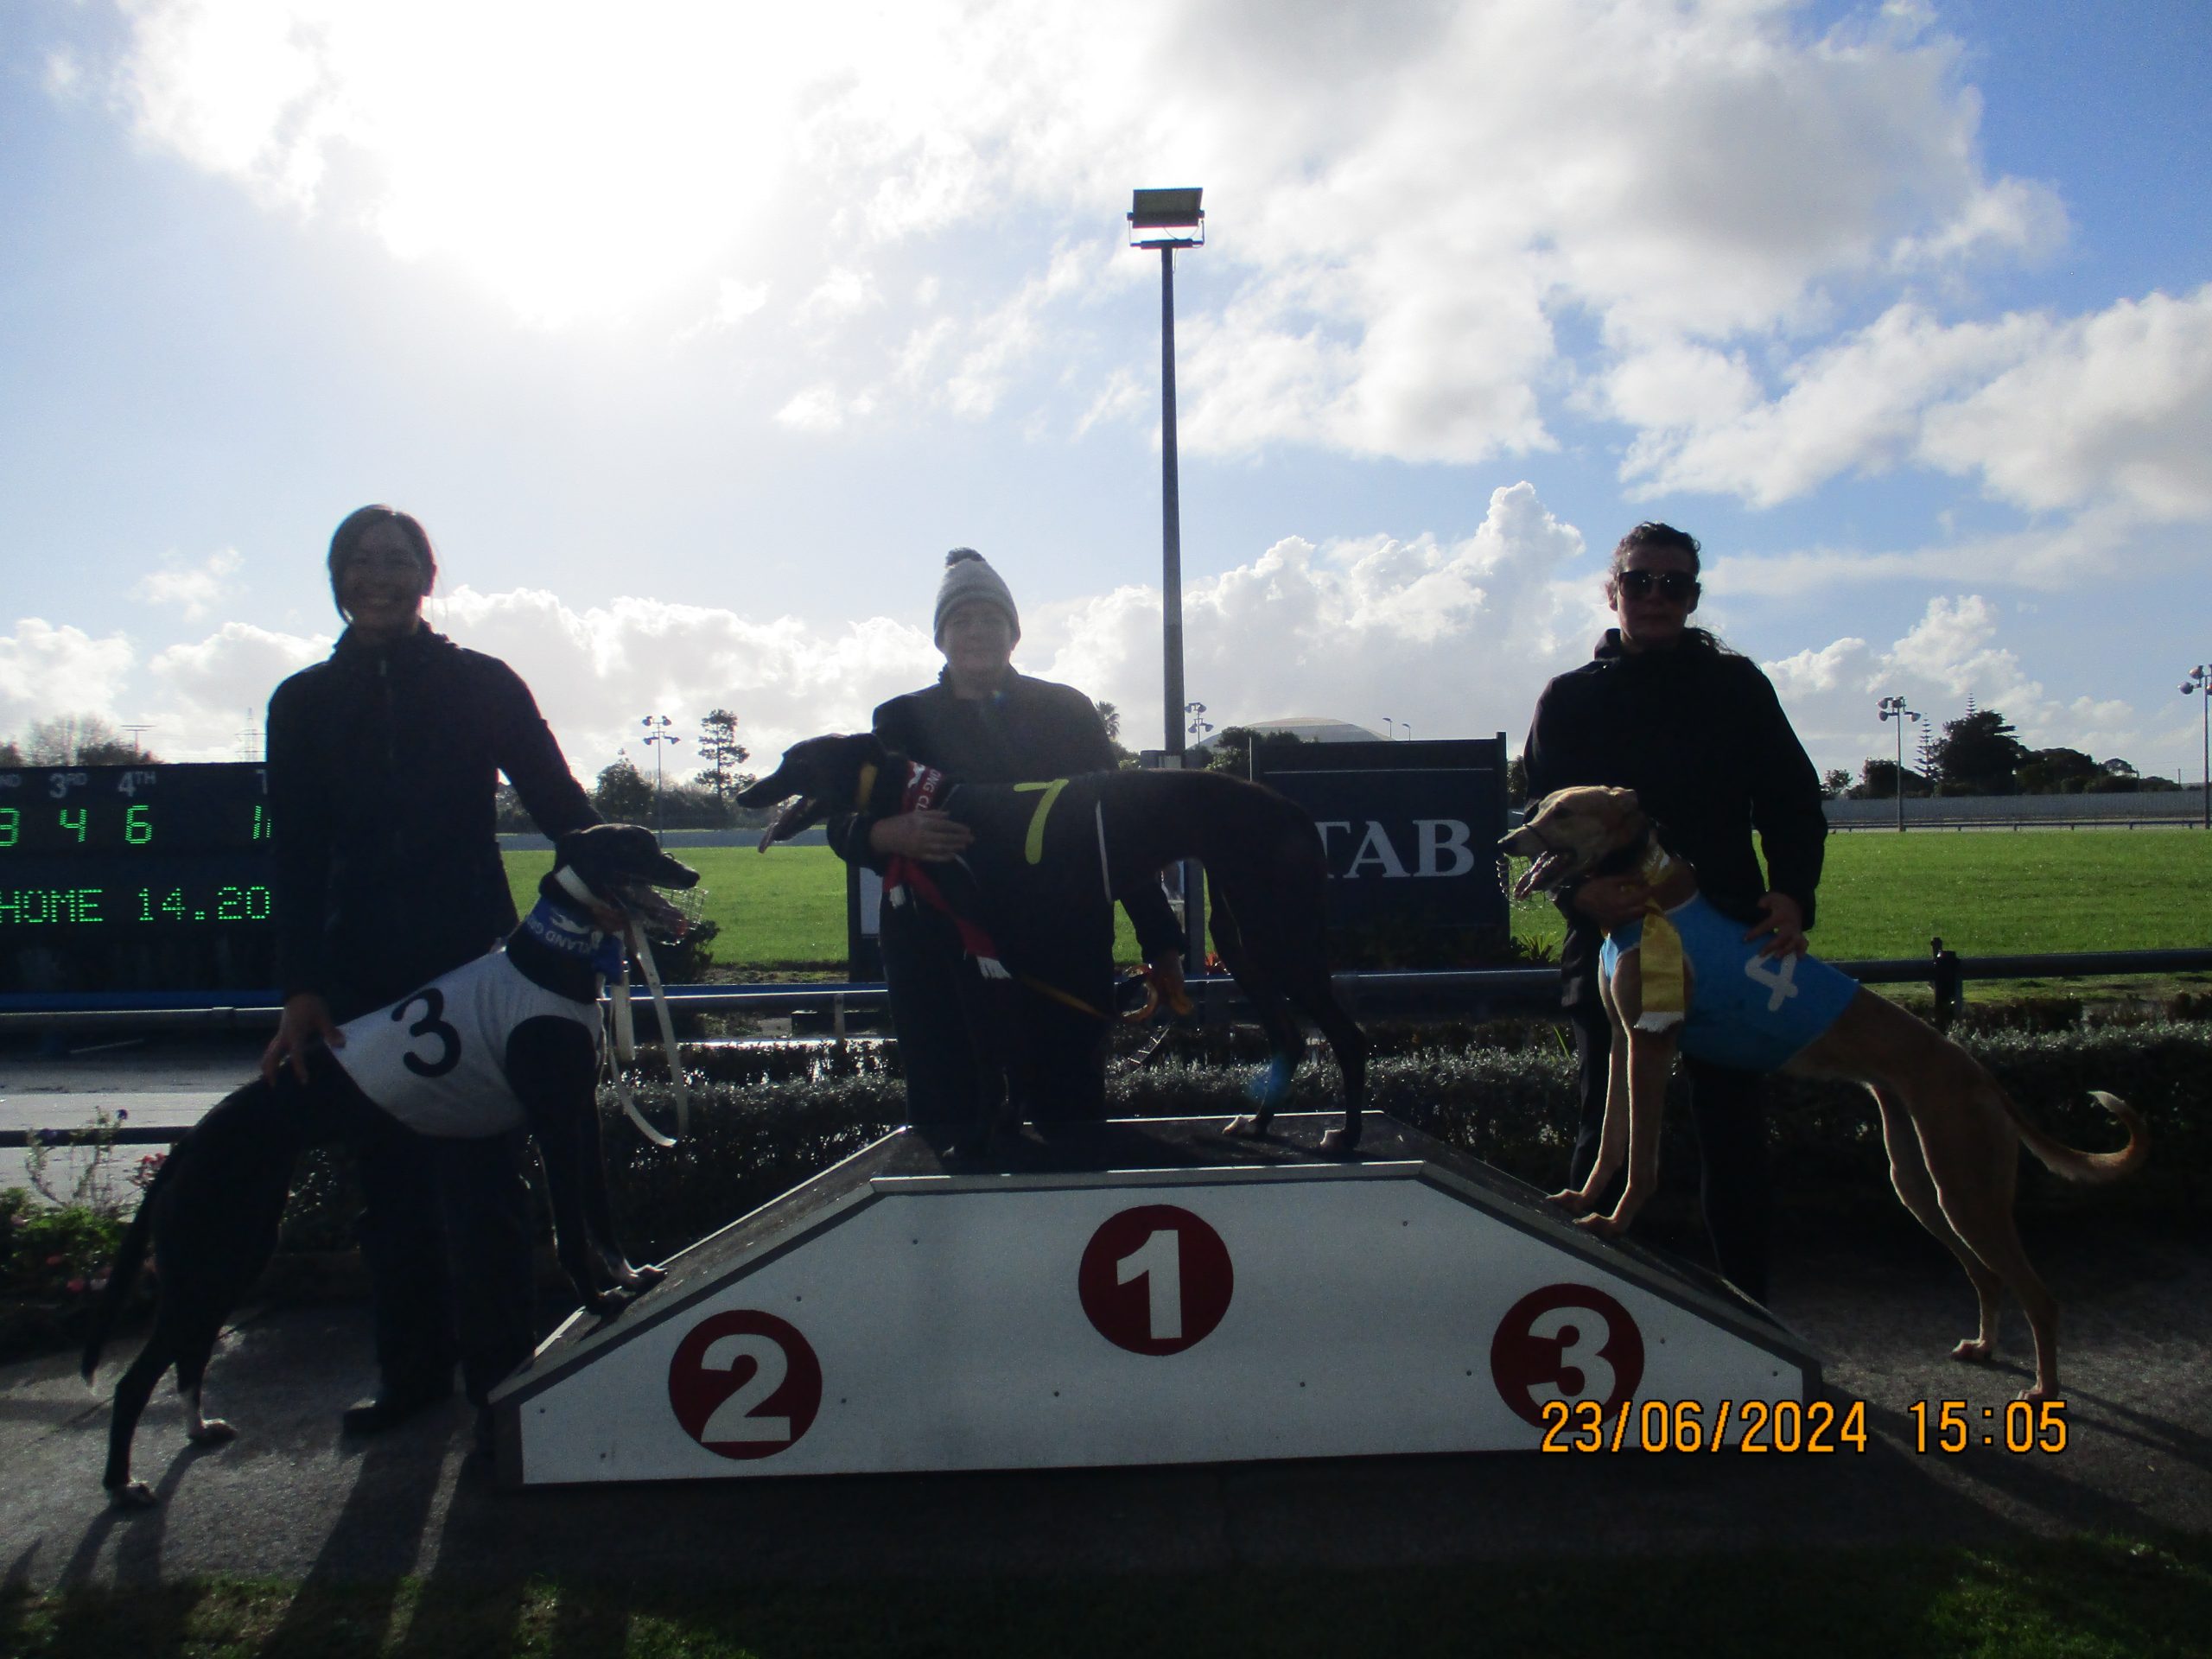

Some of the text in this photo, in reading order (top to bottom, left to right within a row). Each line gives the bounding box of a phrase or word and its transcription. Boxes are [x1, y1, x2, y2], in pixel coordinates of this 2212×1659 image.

[58, 807, 88, 843] 4
[124, 804, 153, 844] 6
[118, 770, 156, 797] 4TH
[1014, 779, 1069, 864] 7
[0, 887, 270, 924] HOME 14.20
[1745, 952, 1798, 1011] 4
[391, 988, 461, 1077] 3
[1116, 1229, 1183, 1340] 1
[701, 1333, 791, 1444] 2
[1526, 1306, 1617, 1419] 3
